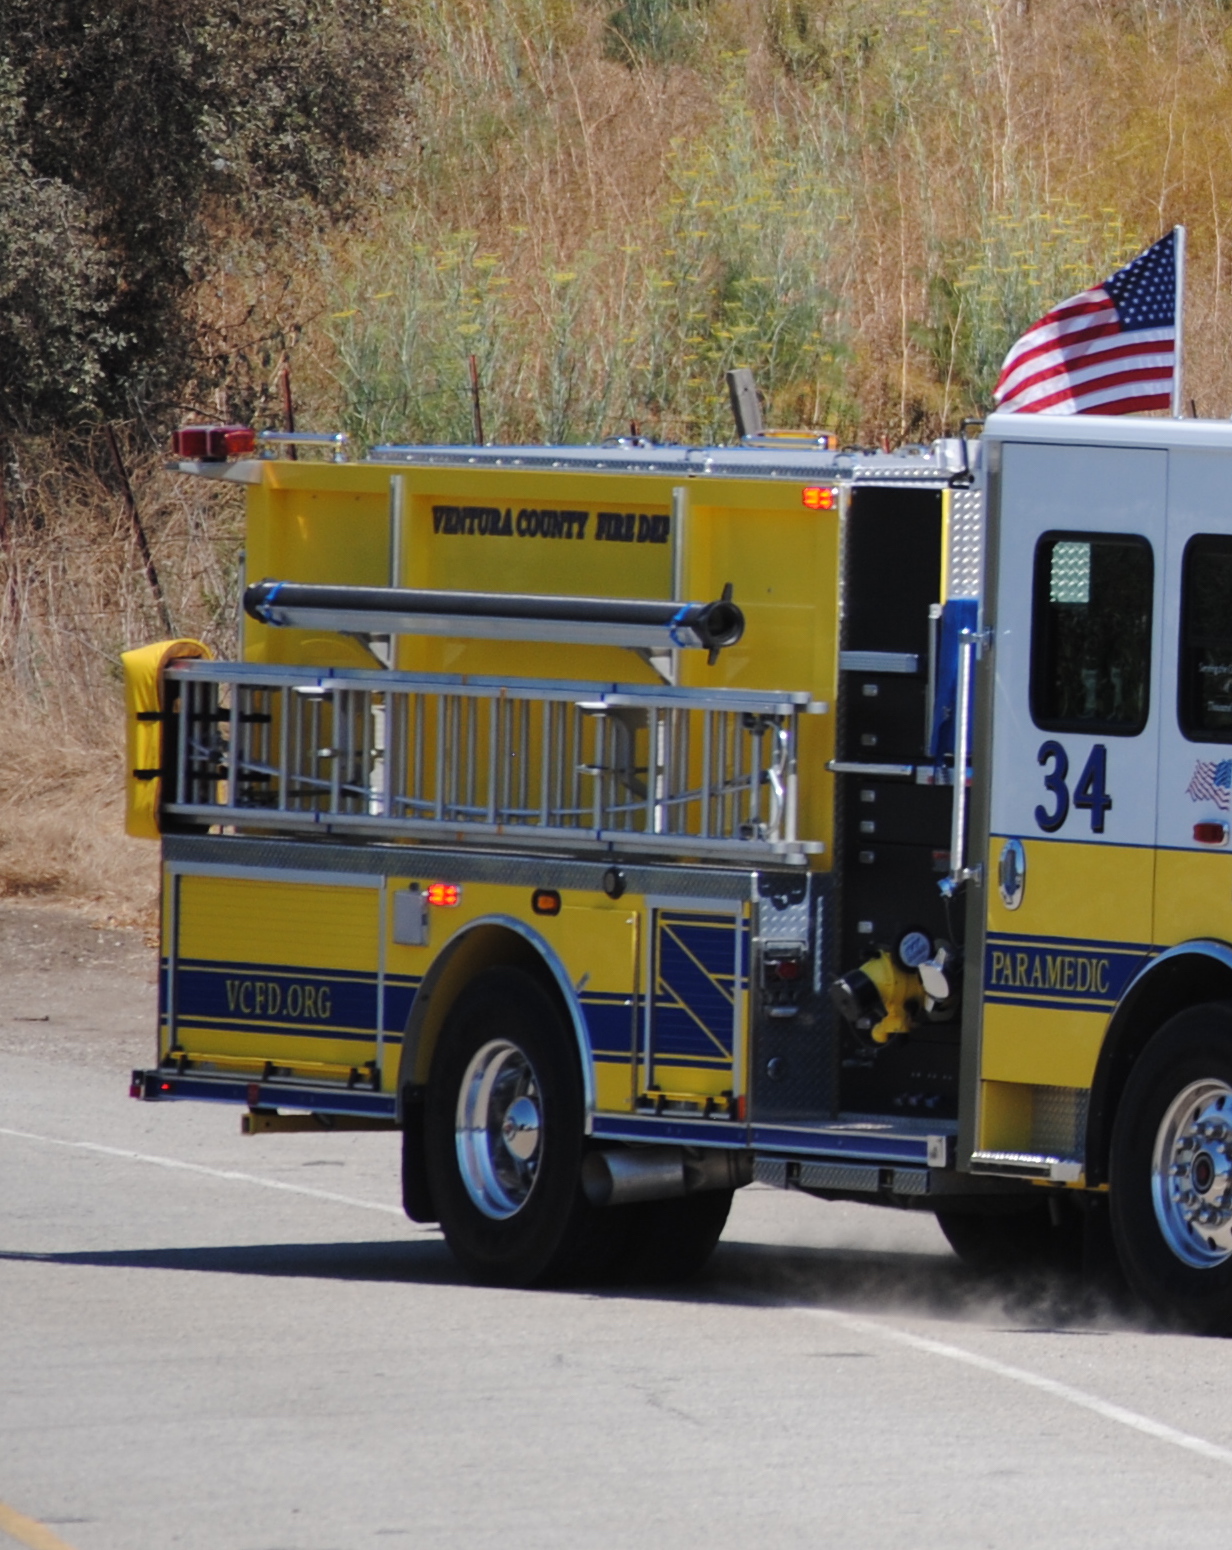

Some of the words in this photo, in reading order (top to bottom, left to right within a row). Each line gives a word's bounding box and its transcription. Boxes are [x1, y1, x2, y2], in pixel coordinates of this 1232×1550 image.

[431, 505, 513, 537] VENTURA
[516, 507, 589, 540] COUNTY
[594, 511, 636, 543] FIRE
[637, 513, 672, 544] DEP
[1034, 739, 1113, 834] 34
[989, 950, 1110, 994] PARAMEDIC
[225, 979, 332, 1018] VCFD.ORG
